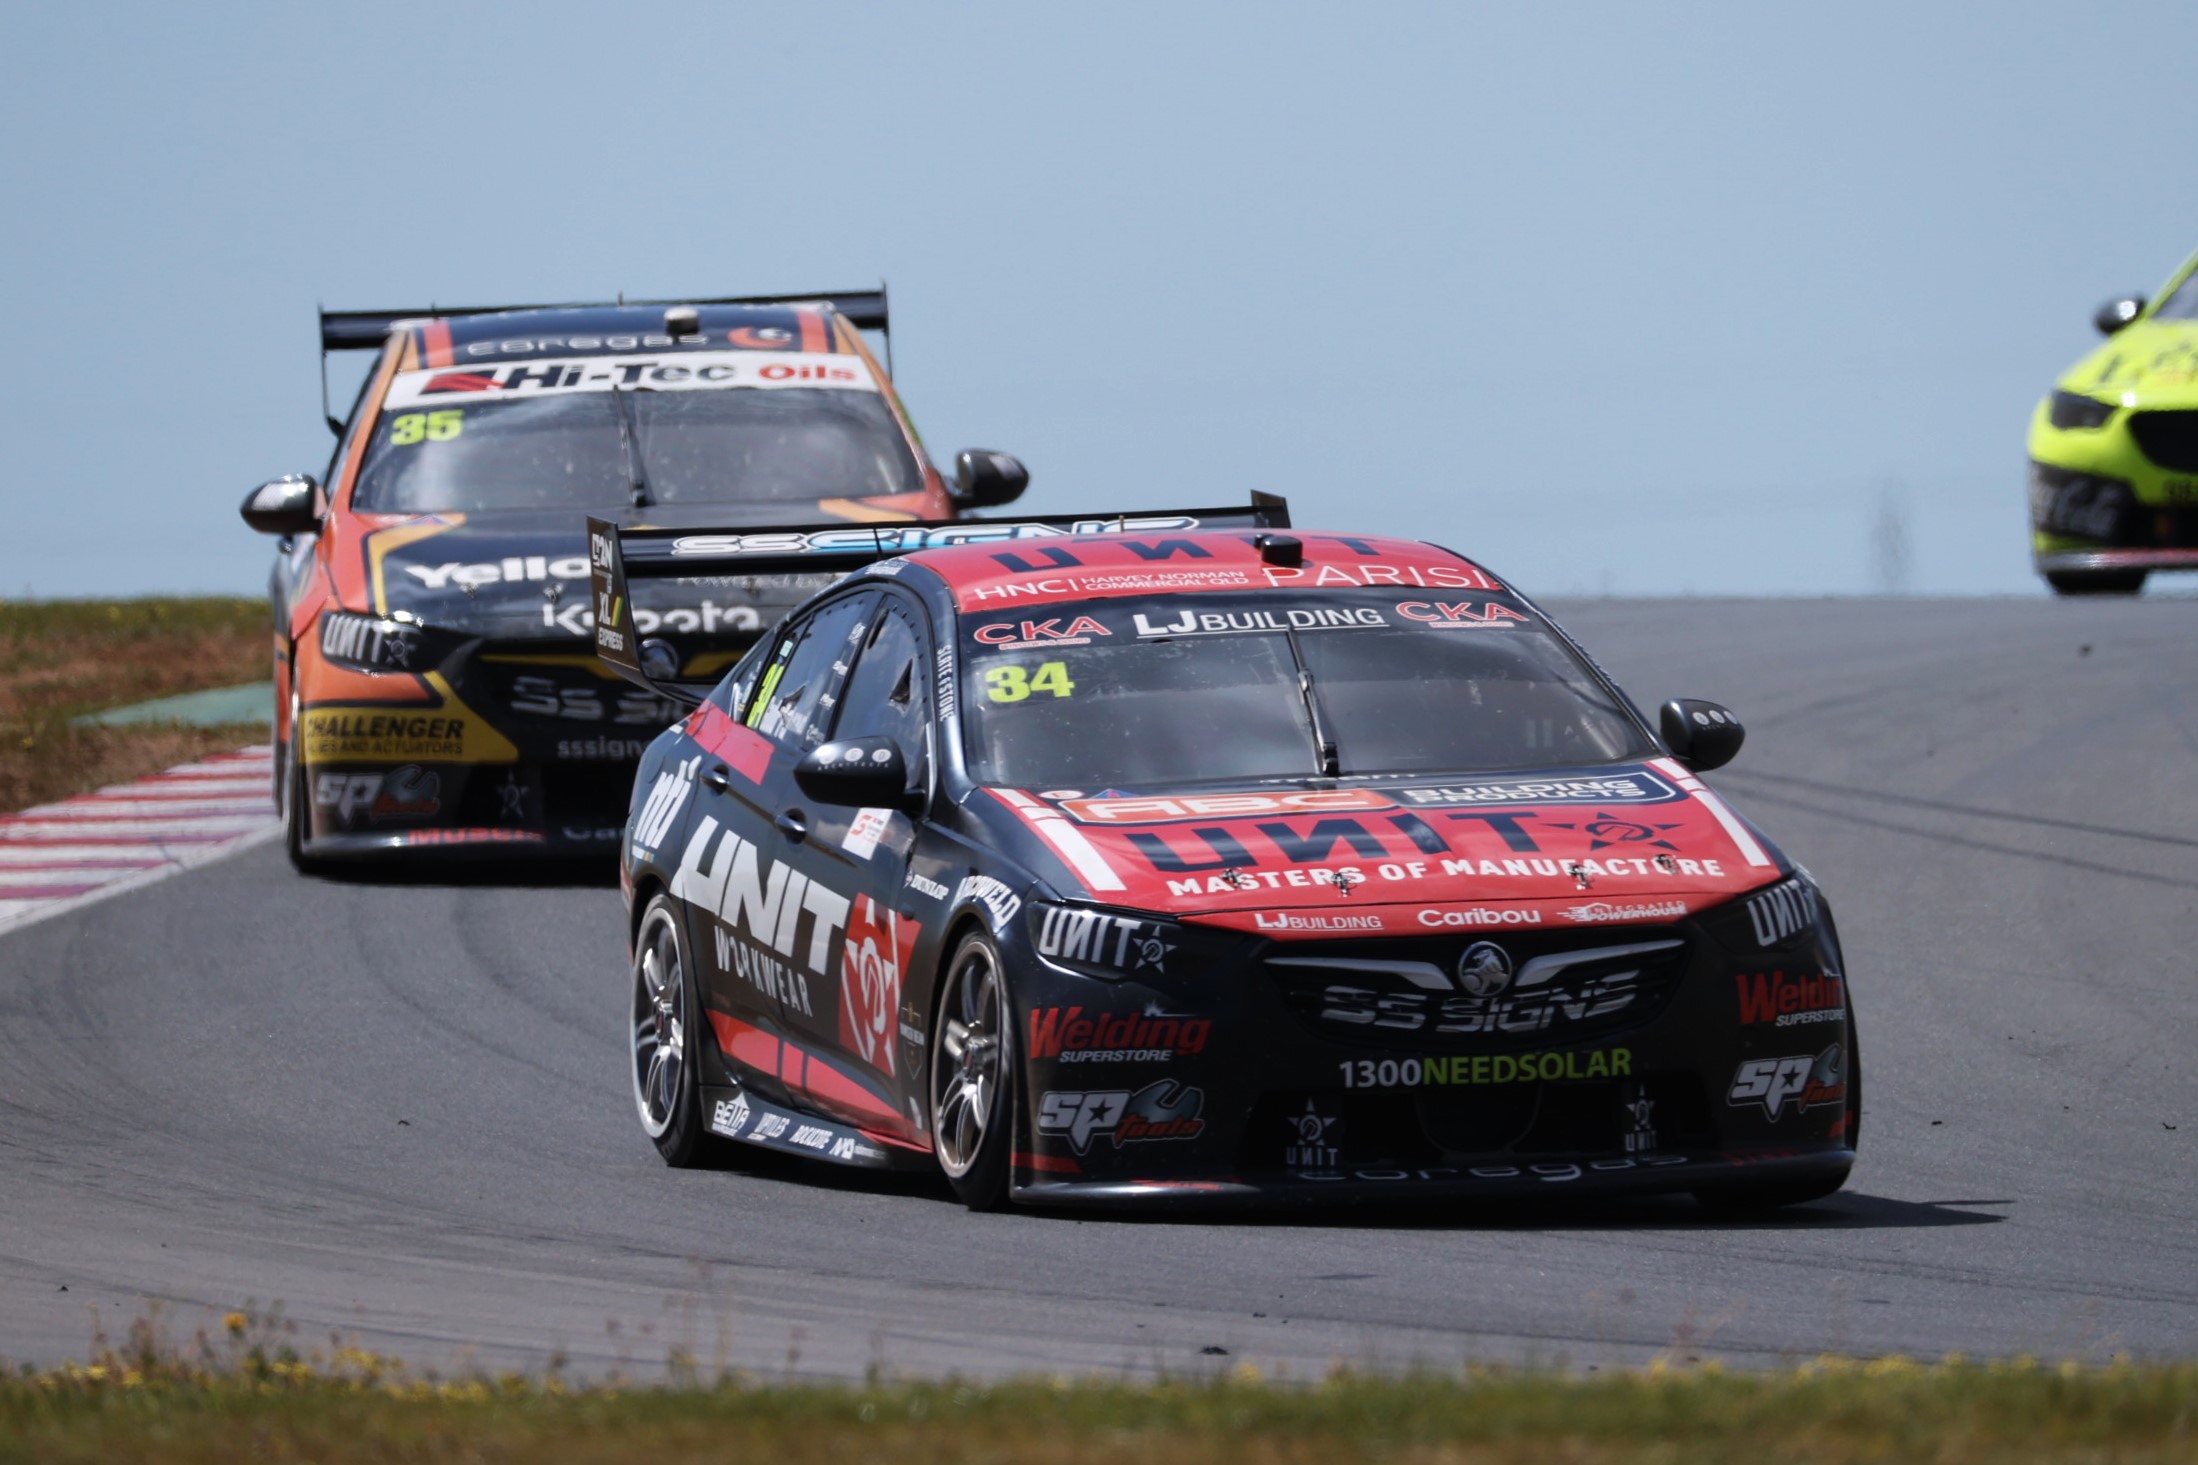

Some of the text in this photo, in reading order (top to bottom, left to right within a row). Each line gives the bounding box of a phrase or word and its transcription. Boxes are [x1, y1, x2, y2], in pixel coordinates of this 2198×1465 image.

[503, 361, 857, 389] Hi-Tec Oils
[389, 409, 465, 446] 35
[405, 556, 593, 589] Yello
[1081, 570, 1246, 585] HARVEY NORMAN
[1085, 577, 1250, 591] COMMERCIAL QLD
[1262, 564, 1491, 589] PARISI
[973, 579, 1067, 600] HNC
[543, 600, 760, 636] Kbota
[1395, 601, 1530, 621] CKA
[973, 616, 1113, 644] CKA
[985, 661, 1075, 703] 34
[556, 735, 650, 761] sssign
[1402, 779, 1632, 798] BUILDING
[1416, 787, 1647, 803] PRODUCTS
[1086, 792, 1371, 818] ABC
[1166, 857, 1727, 897] MASTERS OF MANUFACTURE
[669, 814, 850, 976] UNIT
[1417, 908, 1542, 928] Caribou
[1039, 906, 1142, 968] UNIT
[714, 924, 814, 1018] WORKWEAR
[1735, 969, 1844, 1025] Weldin
[1775, 1008, 1846, 1027] SUPERSTORE
[1029, 1005, 1212, 1061] Welding
[1059, 1049, 1173, 1064] SUPERSTORE
